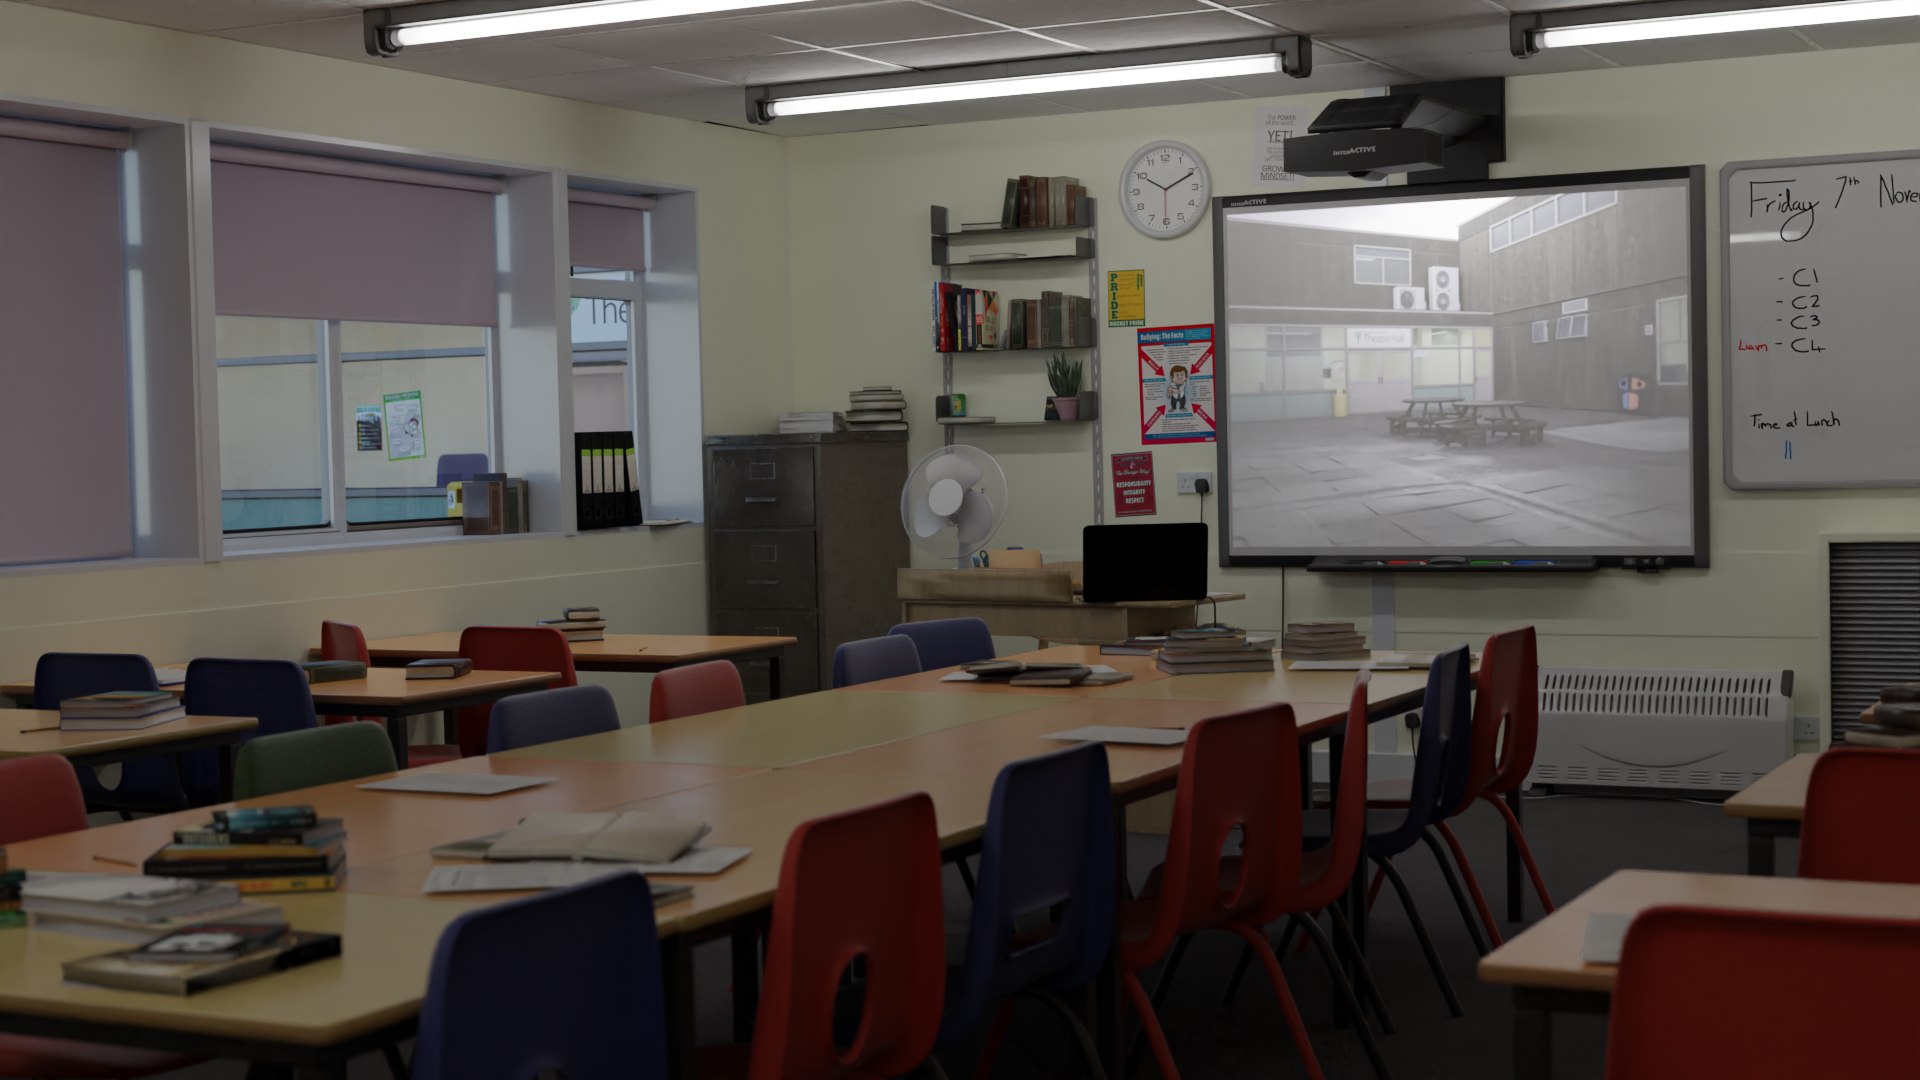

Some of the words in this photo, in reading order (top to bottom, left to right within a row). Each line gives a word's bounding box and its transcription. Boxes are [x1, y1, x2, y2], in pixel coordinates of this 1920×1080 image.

[1160, 154, 1170, 162] 12
[1136, 172, 1148, 180] 10
[1132, 188, 1140, 196] 9
[1191, 183, 1199, 191] 3
[1137, 203, 1145, 211] 8
[1750, 180, 1820, 242] Friday
[1880, 174, 1920, 208] Nove
[1148, 214, 1155, 222] 7
[1177, 212, 1185, 220] 5
[1162, 217, 1171, 226] 6
[1792, 268, 1819, 287] C1
[1110, 273, 1118, 319] PRIDE
[1791, 294, 1821, 310] C2
[1790, 314, 1821, 330] C3
[1140, 332, 1161, 342] Bullying:
[1162, 331, 1170, 339] The
[1364, 333, 1391, 344] Theatre
[1392, 333, 1406, 343] Hall
[1738, 339, 1768, 352] Liam
[1790, 337, 1826, 353] C4
[1750, 413, 1781, 430] Time
[1786, 410, 1798, 427] at
[1806, 410, 1841, 427] Lunch
[1116, 480, 1151, 488] RESPONSIBILITY
